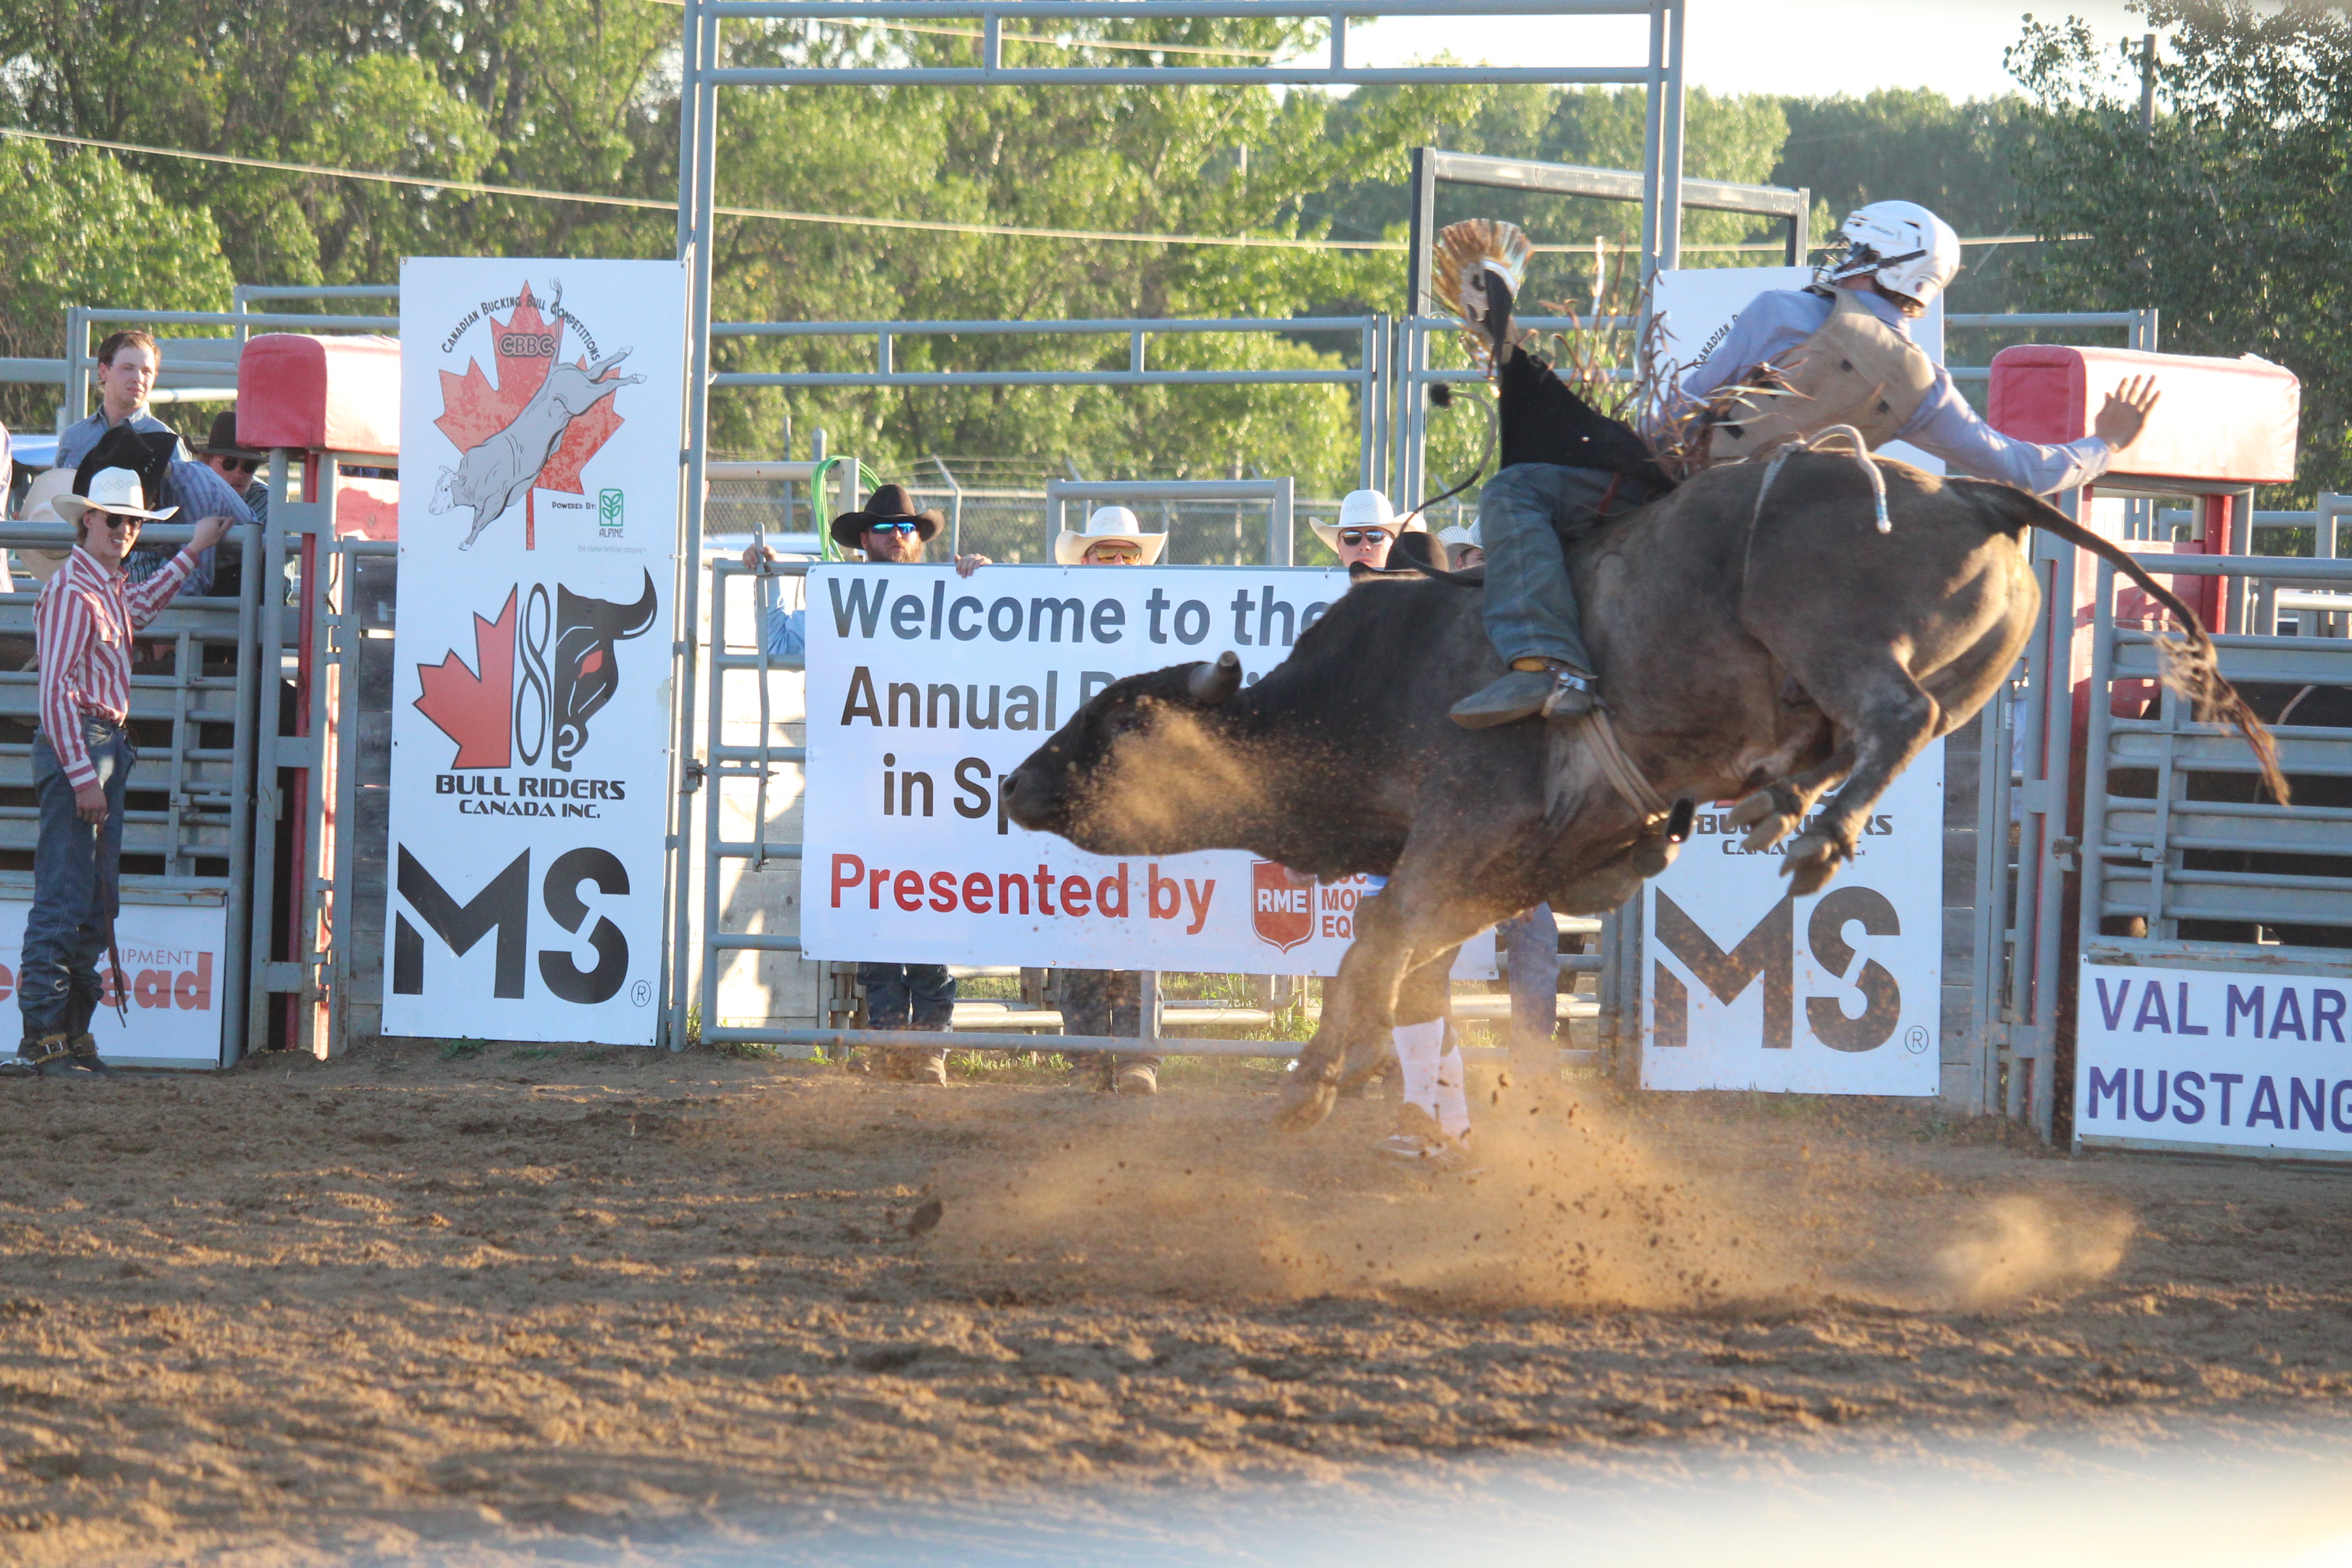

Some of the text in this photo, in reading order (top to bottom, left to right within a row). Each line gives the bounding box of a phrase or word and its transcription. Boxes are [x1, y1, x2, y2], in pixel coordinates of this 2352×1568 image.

[441, 294, 601, 362] CANADIAN BUCKING BULL COMPETITIONS
[499, 333, 557, 357] CBBC
[599, 528, 624, 538] ALPINE
[828, 578, 1126, 644] Welcome
[1146, 587, 1211, 644] to
[840, 666, 1057, 731] Annual
[436, 774, 625, 800] BULL RIDERS
[459, 799, 601, 819] CANADA INC.
[883, 753, 933, 817] in
[393, 840, 630, 1004] MS
[830, 853, 1215, 936] Presented by
[1258, 889, 1307, 913] RME
[1653, 885, 1901, 1053] MS
[2095, 978, 2352, 1043] VAL MAR
[2088, 1066, 2352, 1134] MUSTANG
